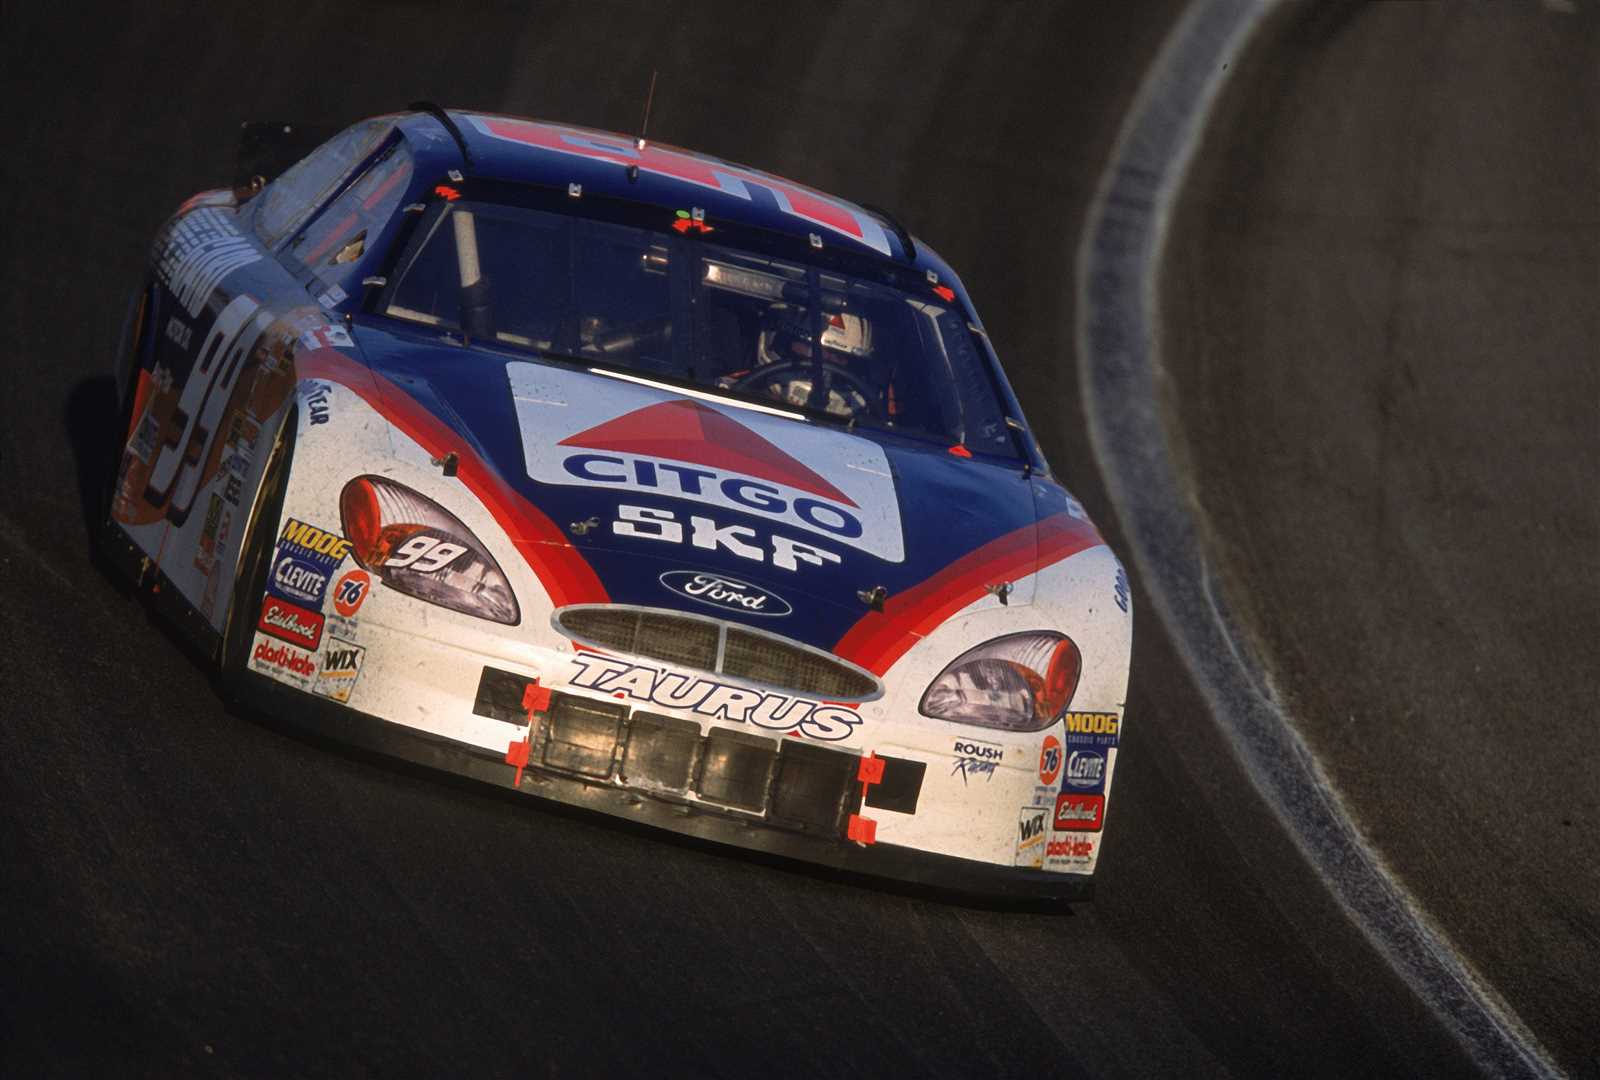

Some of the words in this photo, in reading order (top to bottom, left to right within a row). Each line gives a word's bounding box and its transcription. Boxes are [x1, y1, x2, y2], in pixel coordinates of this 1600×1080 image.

[563, 453, 863, 539] CITGO
[282, 520, 354, 561] MOOG
[384, 535, 469, 572] 99
[612, 503, 842, 571] SKF
[275, 556, 326, 597] CLEVITE
[338, 579, 364, 605] 76
[684, 573, 766, 610] Ford
[264, 605, 318, 640] Edelbrock
[326, 648, 359, 671] WIX
[568, 653, 864, 741] TAURUS
[1065, 713, 1119, 734] MOOG
[954, 742, 1004, 761] ROUSH
[1042, 747, 1060, 772] 76
[1021, 813, 1046, 841] WIX
